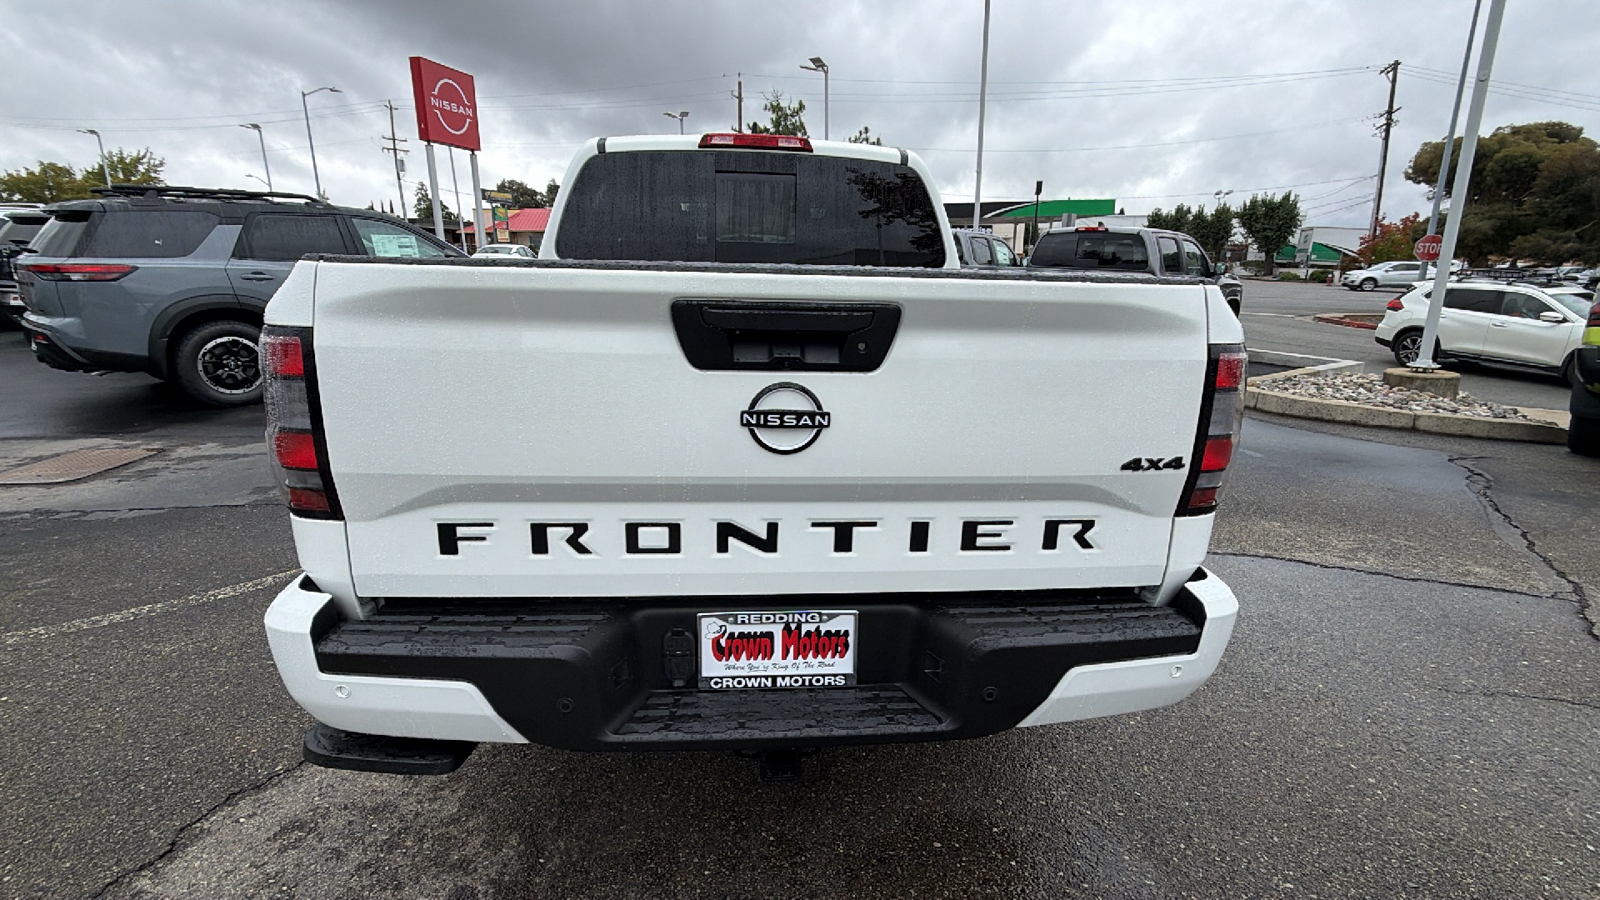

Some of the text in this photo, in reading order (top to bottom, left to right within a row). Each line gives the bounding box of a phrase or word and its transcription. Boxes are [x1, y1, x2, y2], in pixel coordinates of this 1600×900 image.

[430, 96, 472, 117] NISSAN
[742, 413, 829, 426] NISSAN
[436, 519, 1096, 556] FRONTIER
[737, 613, 820, 624] REDDING
[711, 623, 850, 662] Crown Motors
[724, 663, 745, 671] Where
[772, 662, 789, 671] King
[791, 662, 800, 671] Of
[802, 661, 815, 669] The
[816, 661, 836, 669] Road
[710, 676, 846, 689] CROWN MOTORS
